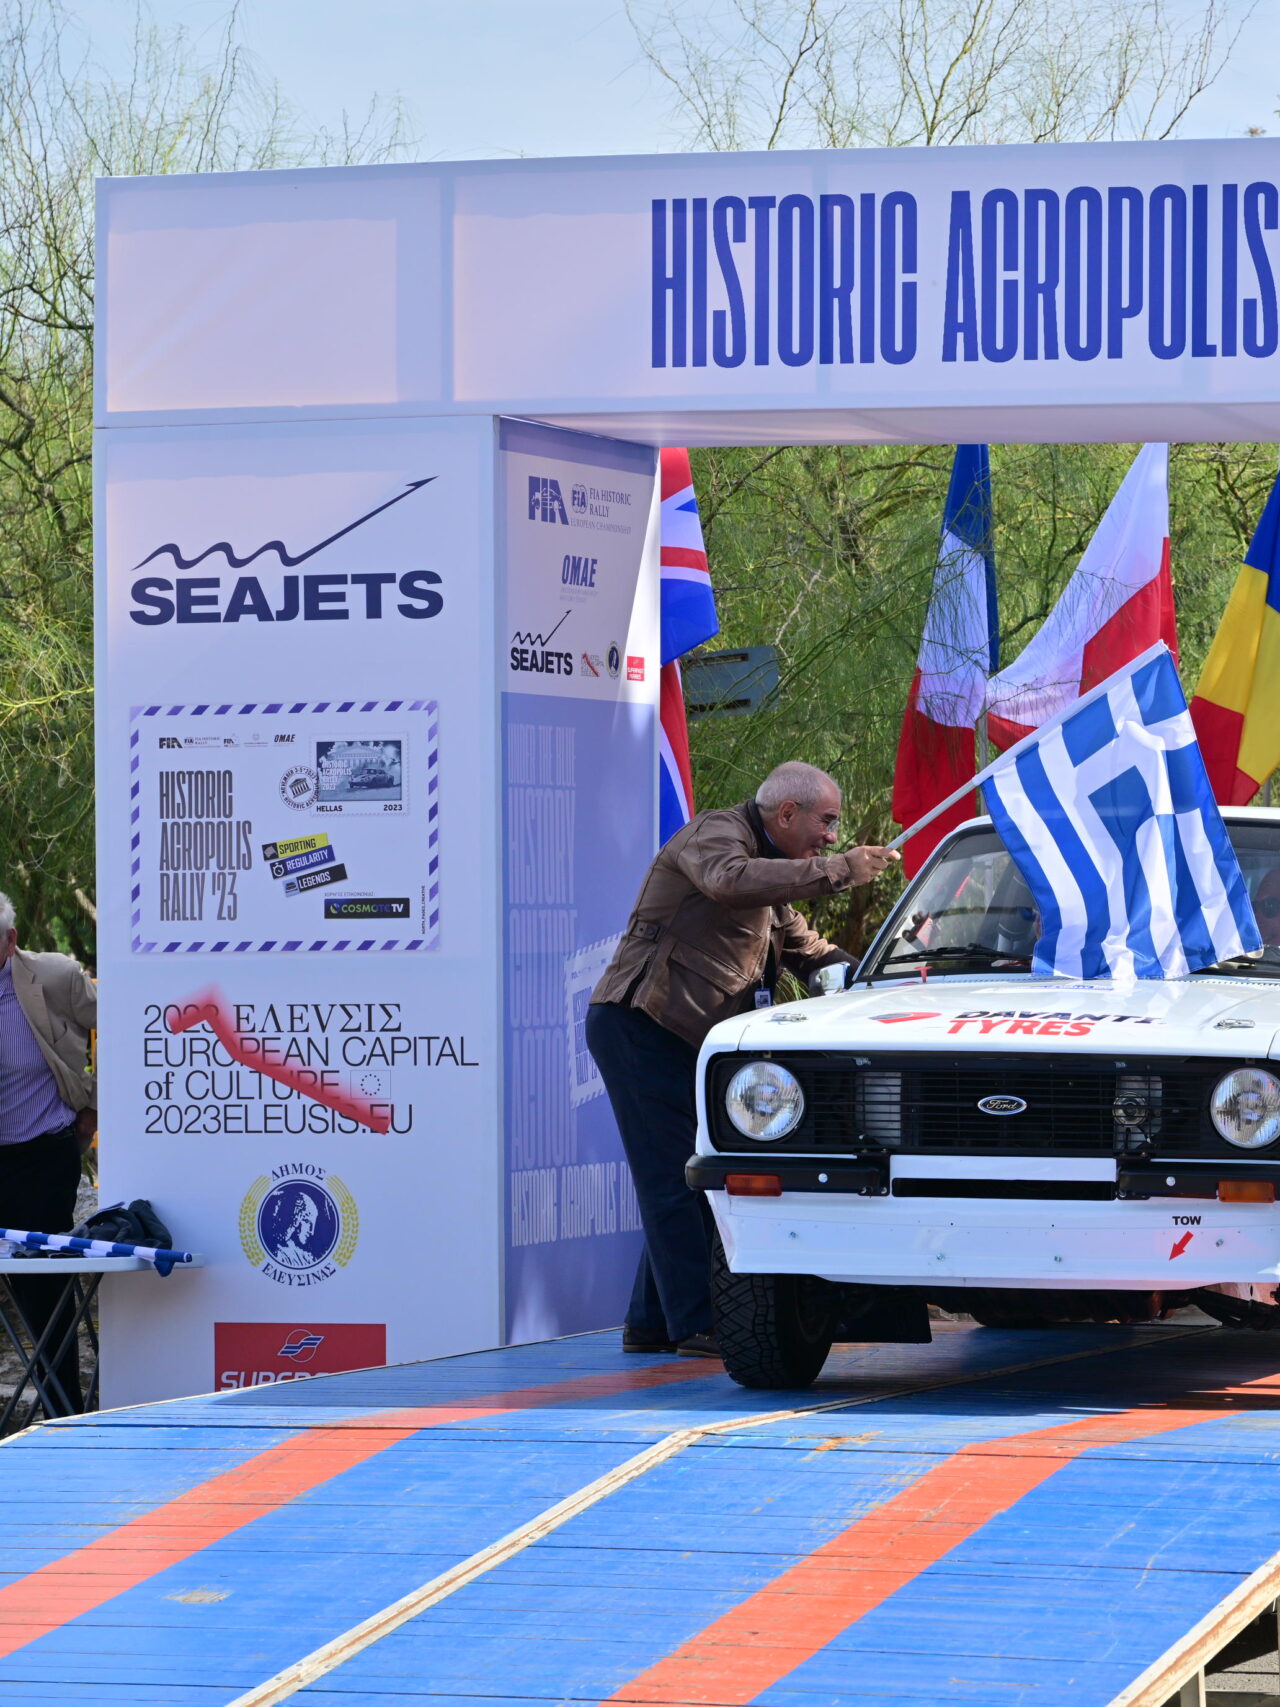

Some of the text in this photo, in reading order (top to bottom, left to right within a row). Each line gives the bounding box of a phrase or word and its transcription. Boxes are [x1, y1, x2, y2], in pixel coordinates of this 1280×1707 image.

[651, 191, 918, 369] HISTORIC
[942, 181, 1279, 363] ACROPOLIS
[528, 475, 587, 526] FIA FIA
[589, 487, 632, 506] FIA HISTORIC
[589, 503, 610, 518] RALLY
[561, 554, 598, 588] OMAE
[129, 570, 444, 626] SEAJETS
[510, 646, 573, 676] SEAJETS
[159, 737, 183, 749] FIA
[273, 734, 296, 743] OMAE
[158, 770, 233, 819] HISTORIC
[383, 804, 403, 812] 2023
[159, 821, 252, 872] ACROPOLIS
[278, 838, 317, 855] SPORTING
[508, 786, 576, 906] HISTORY
[286, 849, 329, 871] REGULARITY
[298, 871, 331, 890] LEGENDS
[159, 872, 205, 922] RALLY
[341, 903, 404, 913] COSMOTE TV
[947, 1019, 1097, 1037] TYRES
[144, 1036, 479, 1068] EUROPEAN CAPITAL
[144, 1070, 340, 1100] of CULTURE
[986, 1099, 1018, 1110] Ford
[145, 1104, 413, 1134] 2023ELEUSIS.EU
[269, 1162, 326, 1183] ΔΗΜΟΣ
[511, 1167, 557, 1247] HISTORIC
[560, 1161, 616, 1240] ACROPOLIS
[1172, 1215, 1202, 1226] TOW
[261, 1262, 337, 1287] ΕΛΕΥΣΙΝΑΣ
